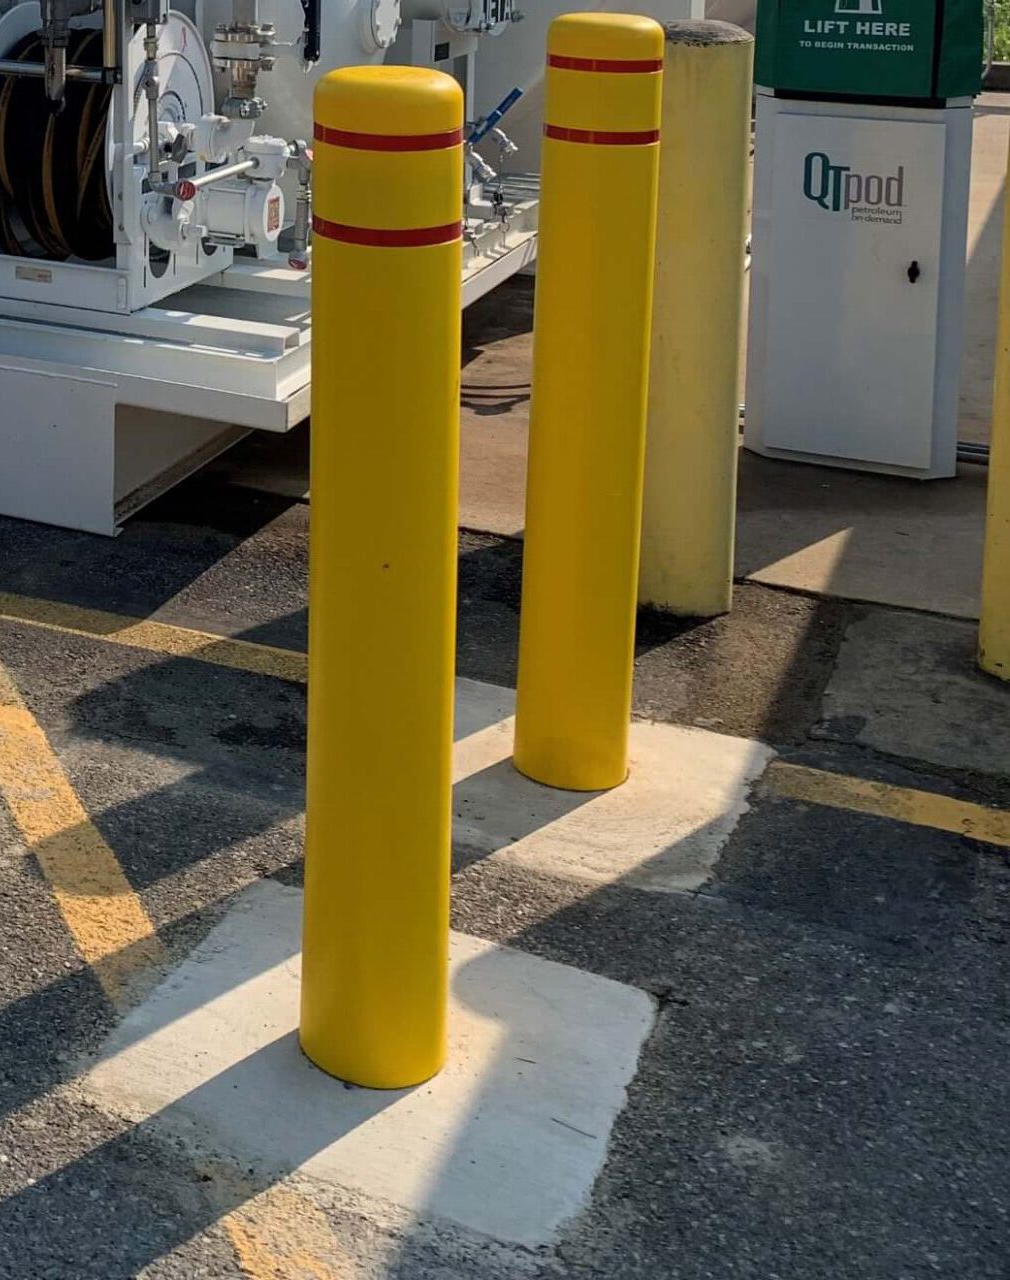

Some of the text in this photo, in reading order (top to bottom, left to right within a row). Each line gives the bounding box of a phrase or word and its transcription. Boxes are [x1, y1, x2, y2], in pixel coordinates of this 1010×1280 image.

[803, 20, 911, 37] LIFT HERE
[799, 40, 915, 52] TO BEGIN TRANSACTION
[803, 152, 904, 211] QTpod
[851, 207, 902, 216] petroleum
